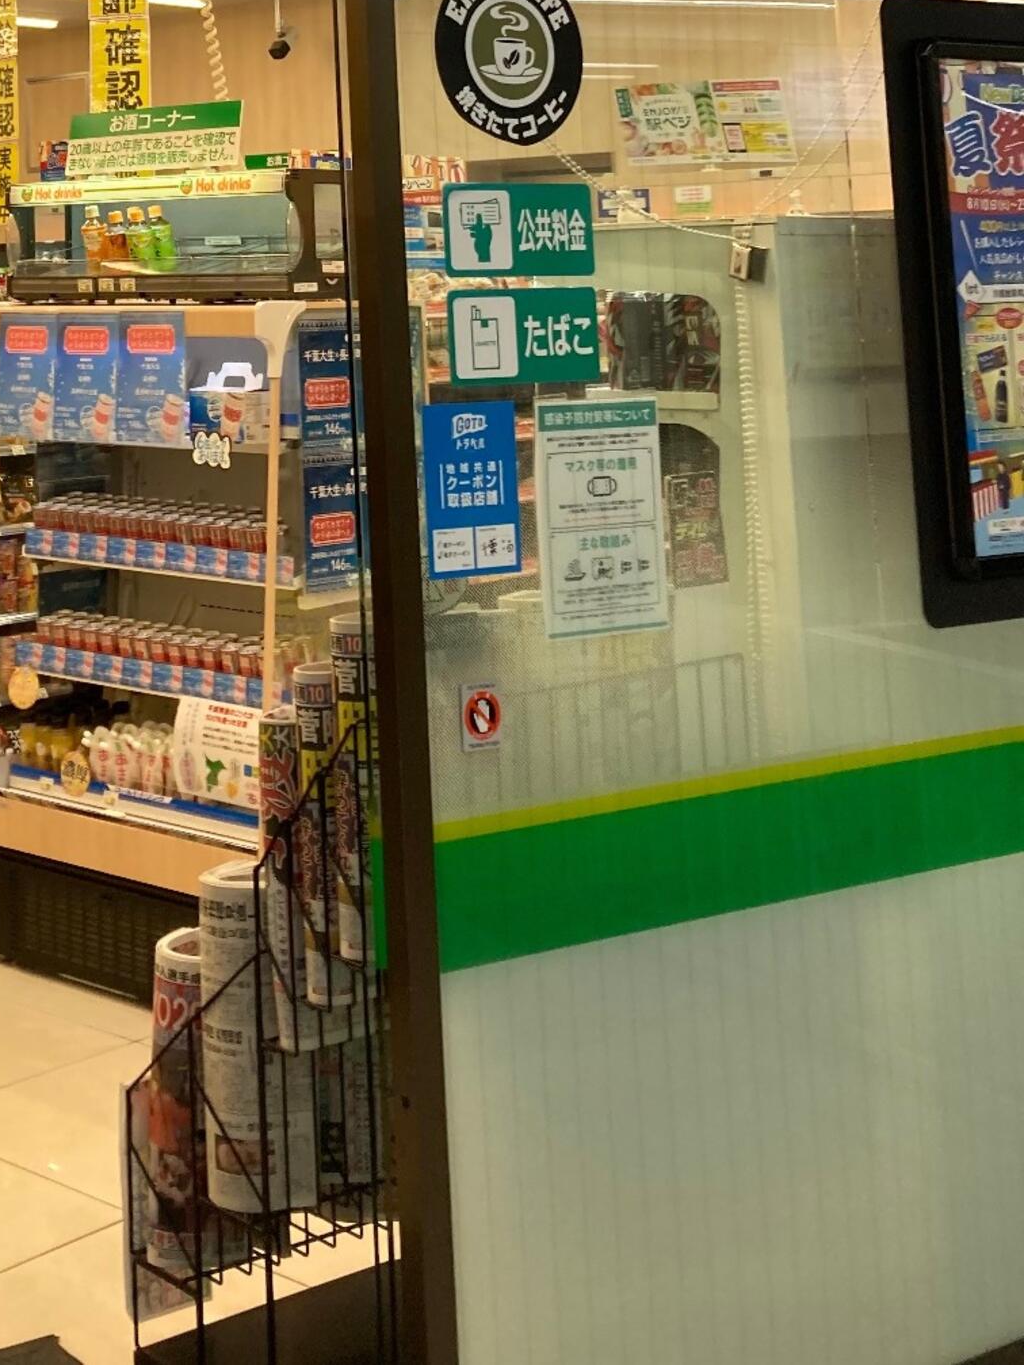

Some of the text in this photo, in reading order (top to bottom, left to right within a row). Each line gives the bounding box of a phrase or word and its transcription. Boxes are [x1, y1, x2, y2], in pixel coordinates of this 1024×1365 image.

[109, 109, 197, 133] お酒コーナー
[35, 185, 83, 200] Hot drinks
[196, 177, 252, 193] Hot drinks
[517, 208, 587, 253] 公共料金
[523, 314, 595, 359] たばこ
[446, 474, 498, 491] クーポン
